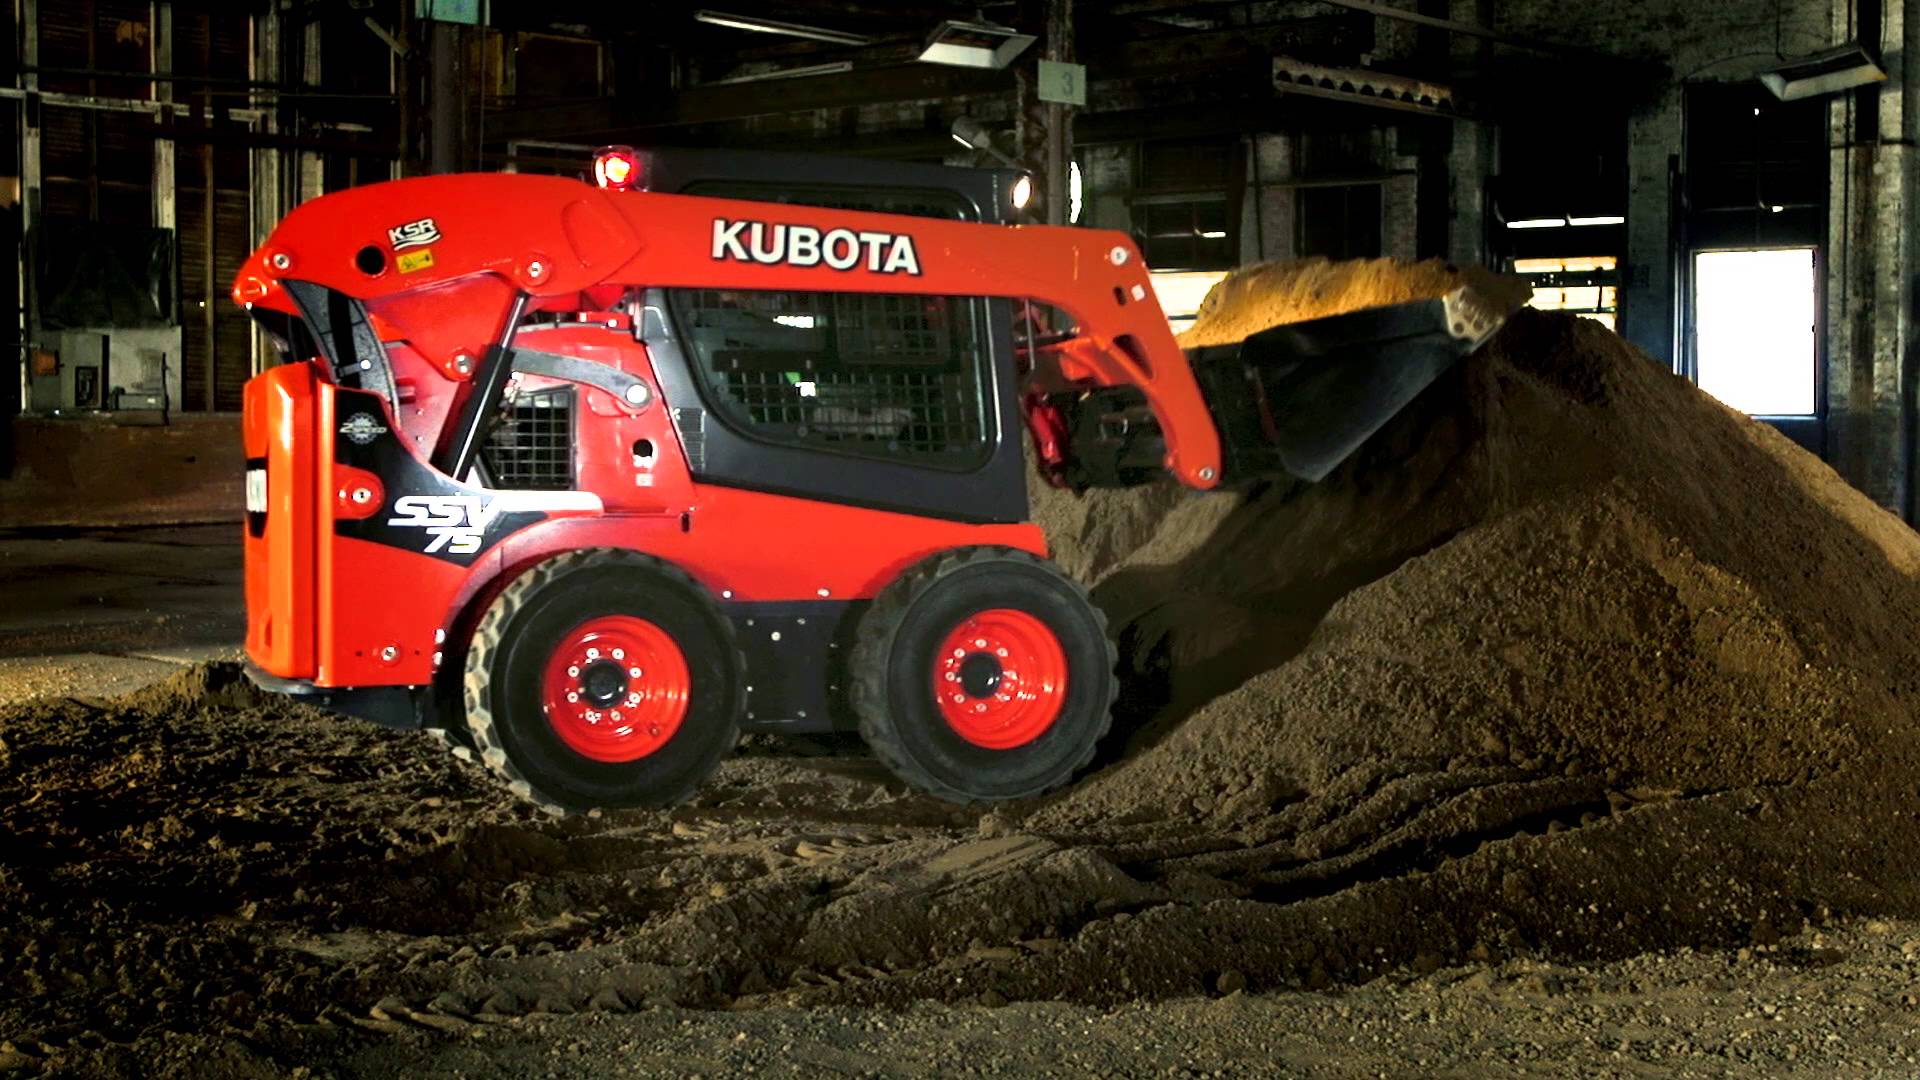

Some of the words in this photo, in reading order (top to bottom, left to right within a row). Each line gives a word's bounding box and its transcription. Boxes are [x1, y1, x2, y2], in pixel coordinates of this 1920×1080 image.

[1062, 71, 1074, 97] 3
[388, 218, 436, 243] KSR
[712, 219, 919, 274] KUBOTA
[387, 495, 499, 528] SSV
[423, 527, 485, 554] 75
